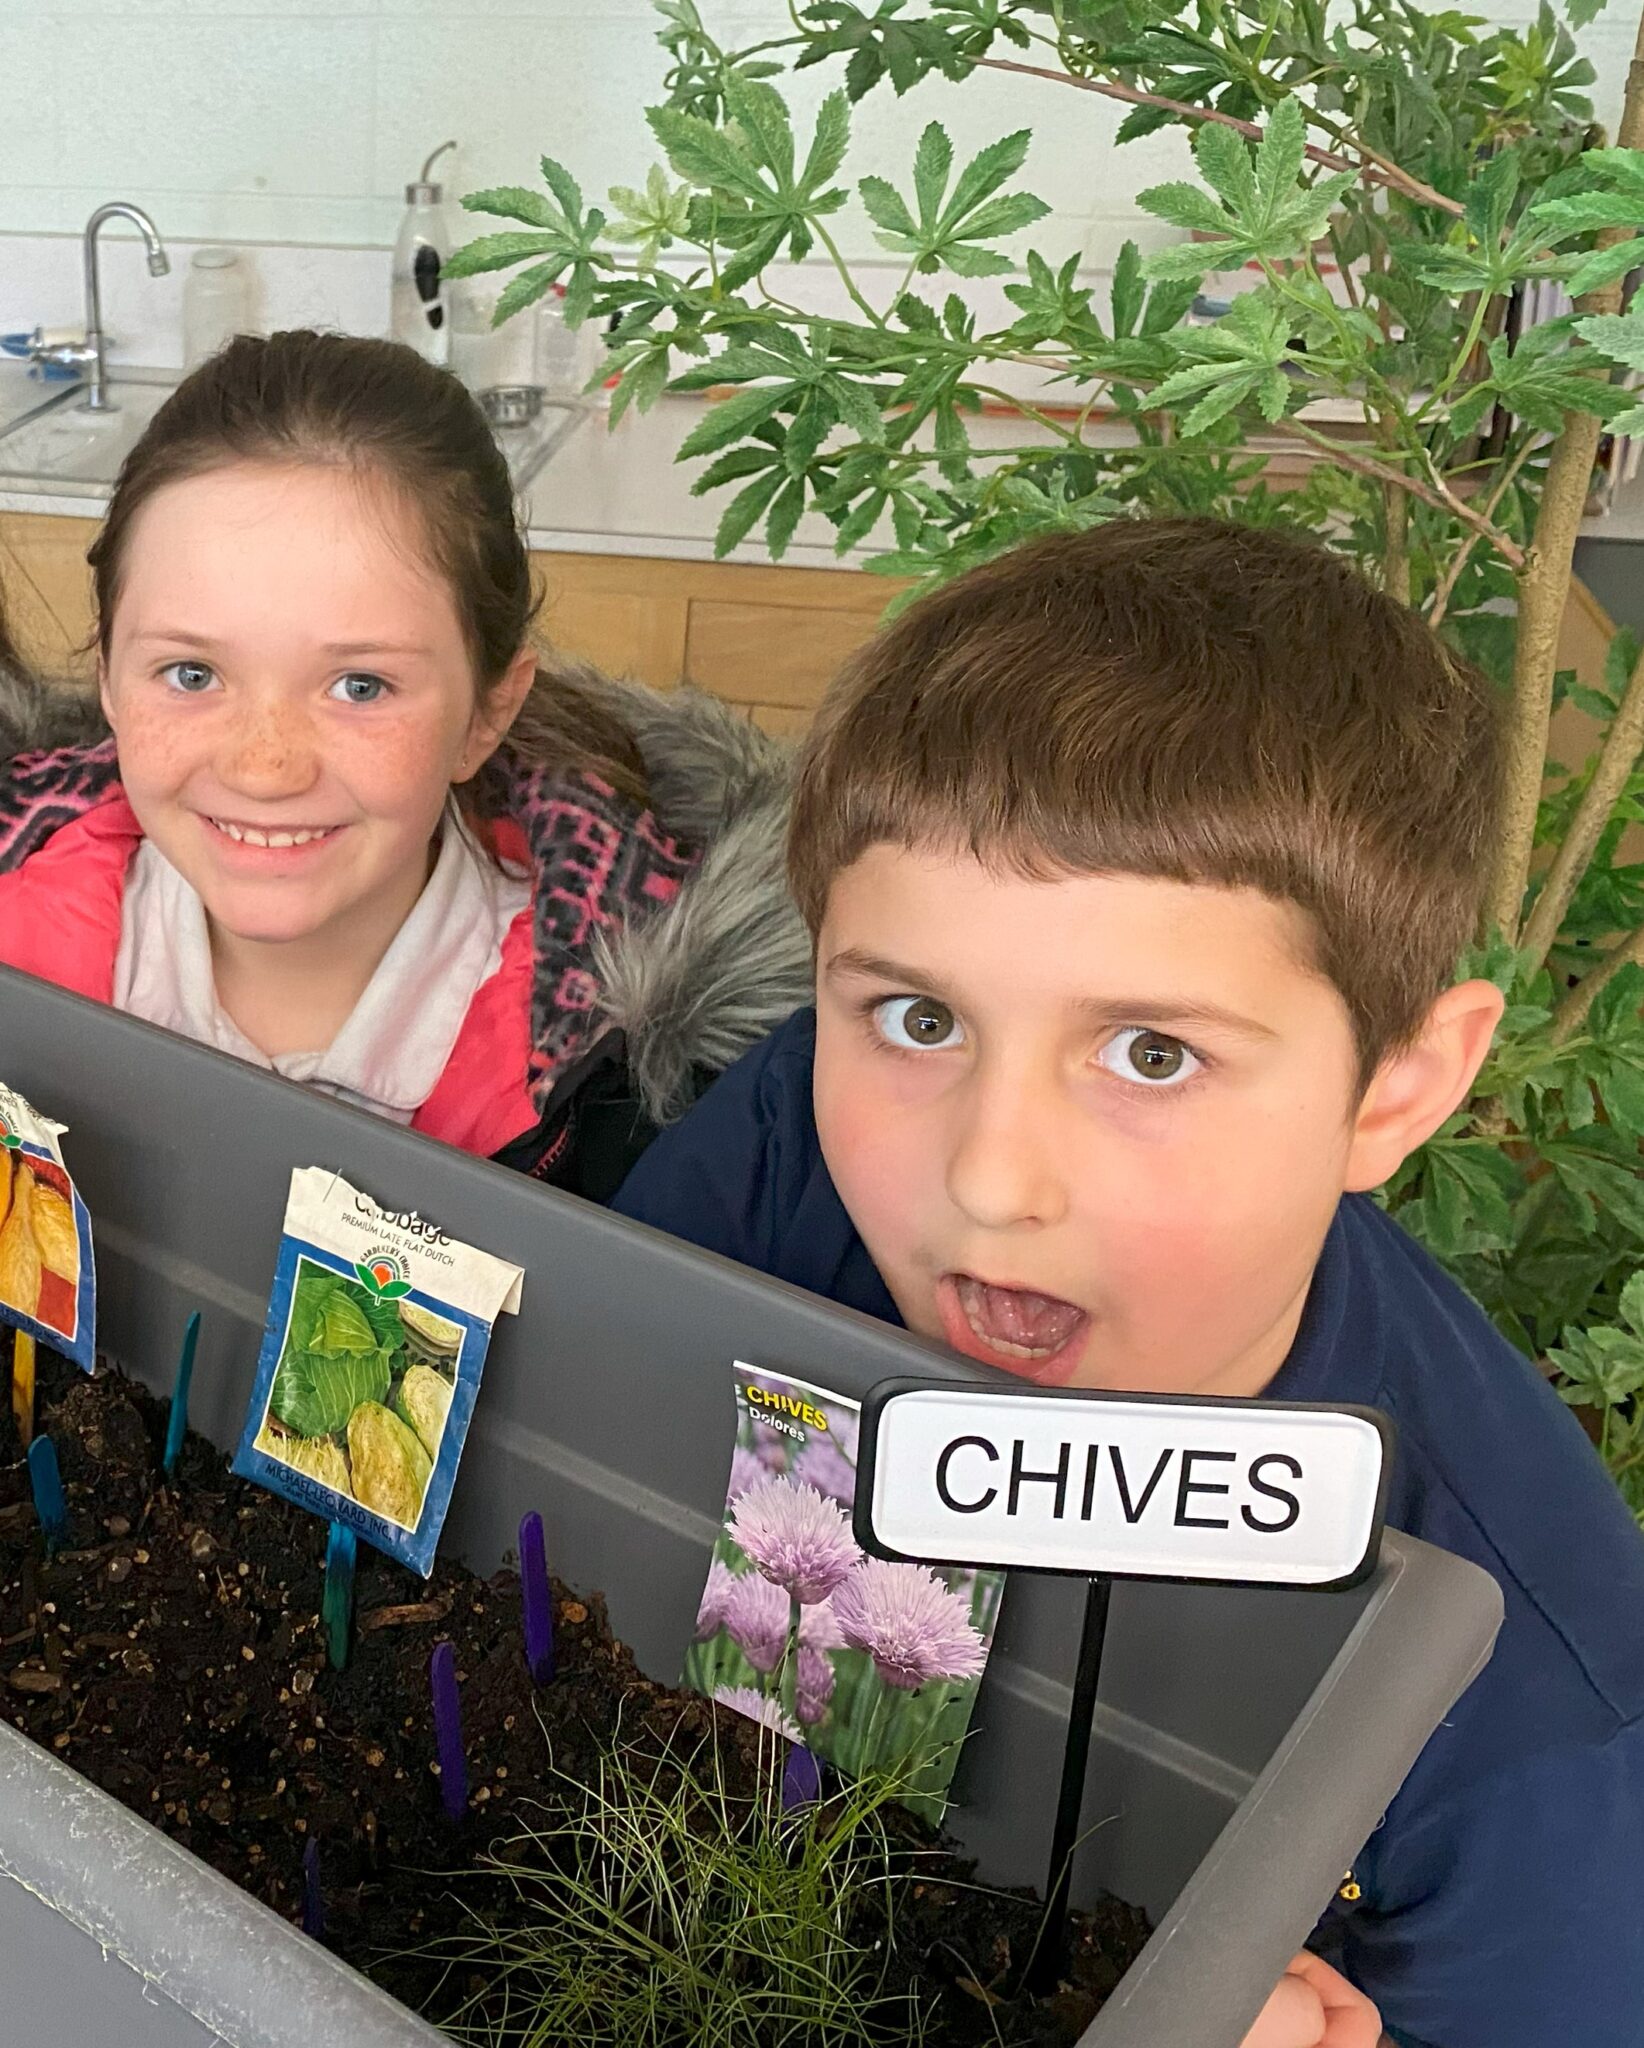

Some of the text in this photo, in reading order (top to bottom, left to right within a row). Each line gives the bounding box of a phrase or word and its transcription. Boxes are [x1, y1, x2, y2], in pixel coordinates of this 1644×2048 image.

[341, 1212, 456, 1267] PREMIUM LATE FLAT DUTCH
[746, 1385, 828, 1431] CHIVES
[748, 1406, 805, 1442] Dolores
[936, 1435, 1303, 1533] CHIVES
[368, 1518, 393, 1543] INC.
